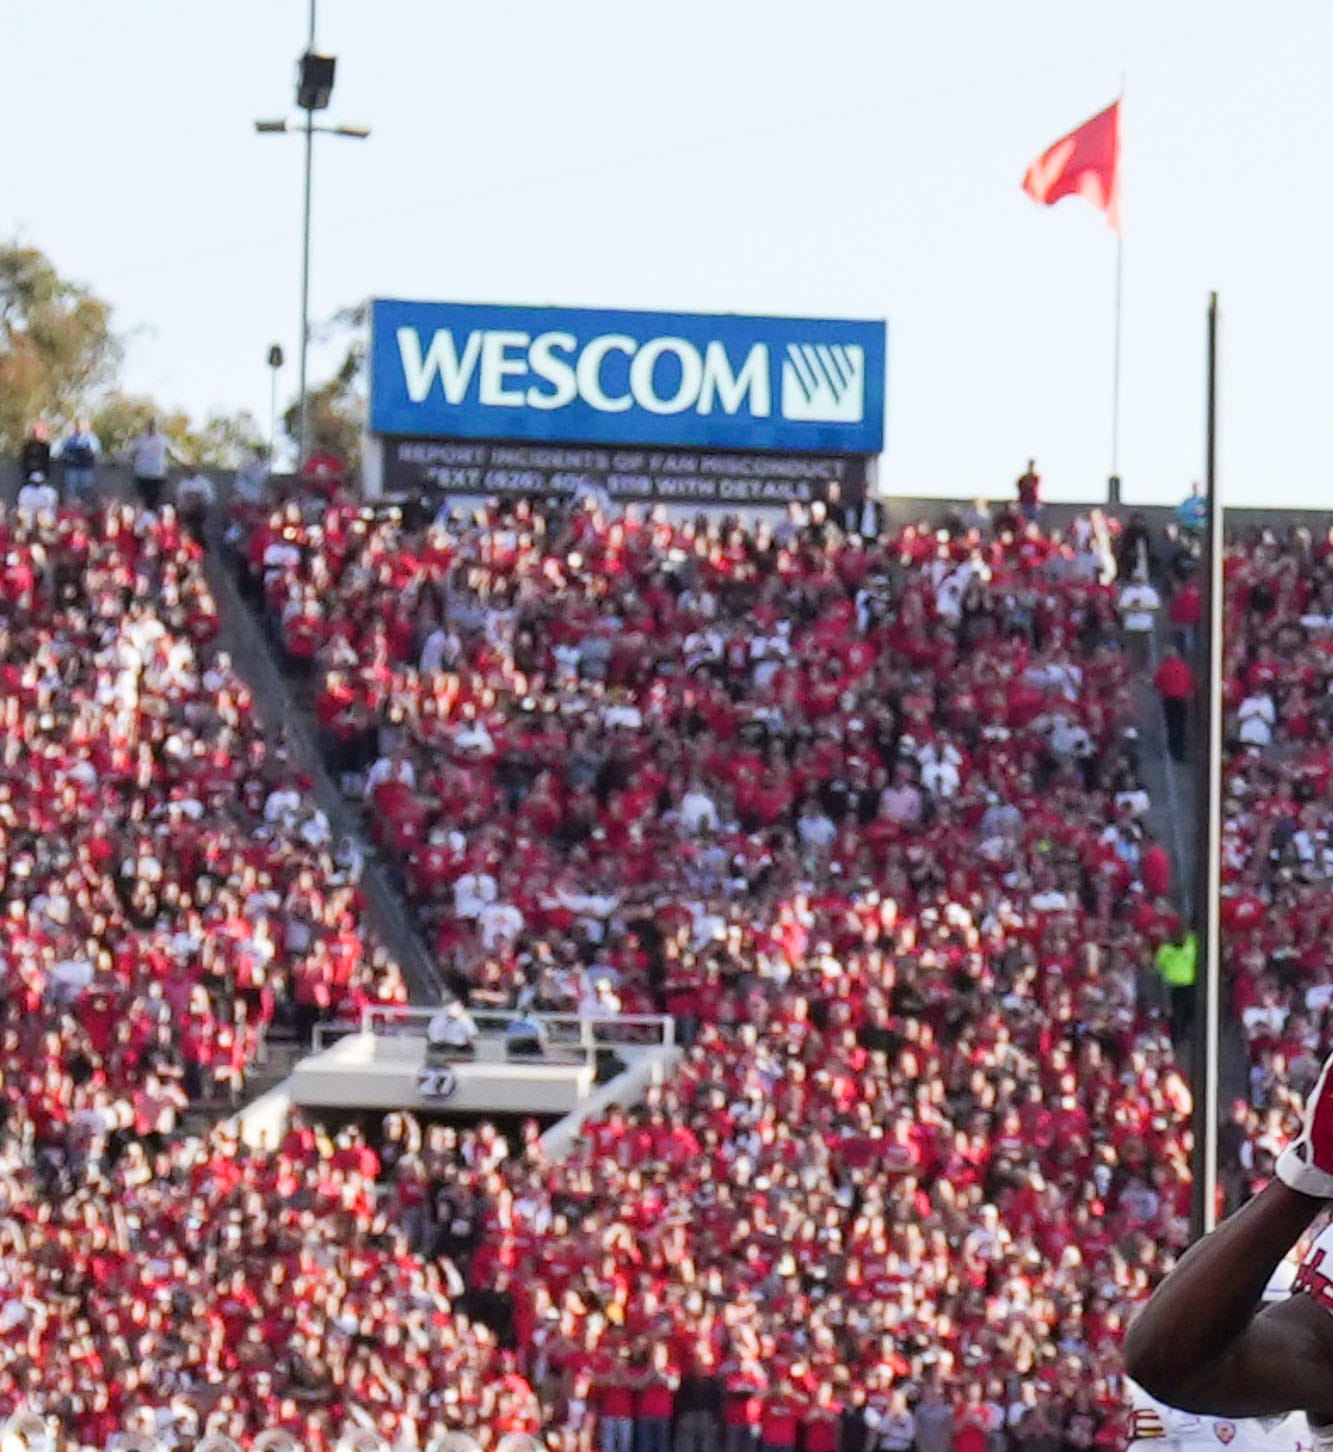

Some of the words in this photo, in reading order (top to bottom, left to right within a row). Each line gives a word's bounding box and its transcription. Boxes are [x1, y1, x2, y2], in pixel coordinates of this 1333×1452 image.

[397, 327, 770, 418] WESCOM
[399, 442, 486, 466] REPORT
[654, 475, 716, 498] WITH
[418, 1070, 454, 1096] 27
